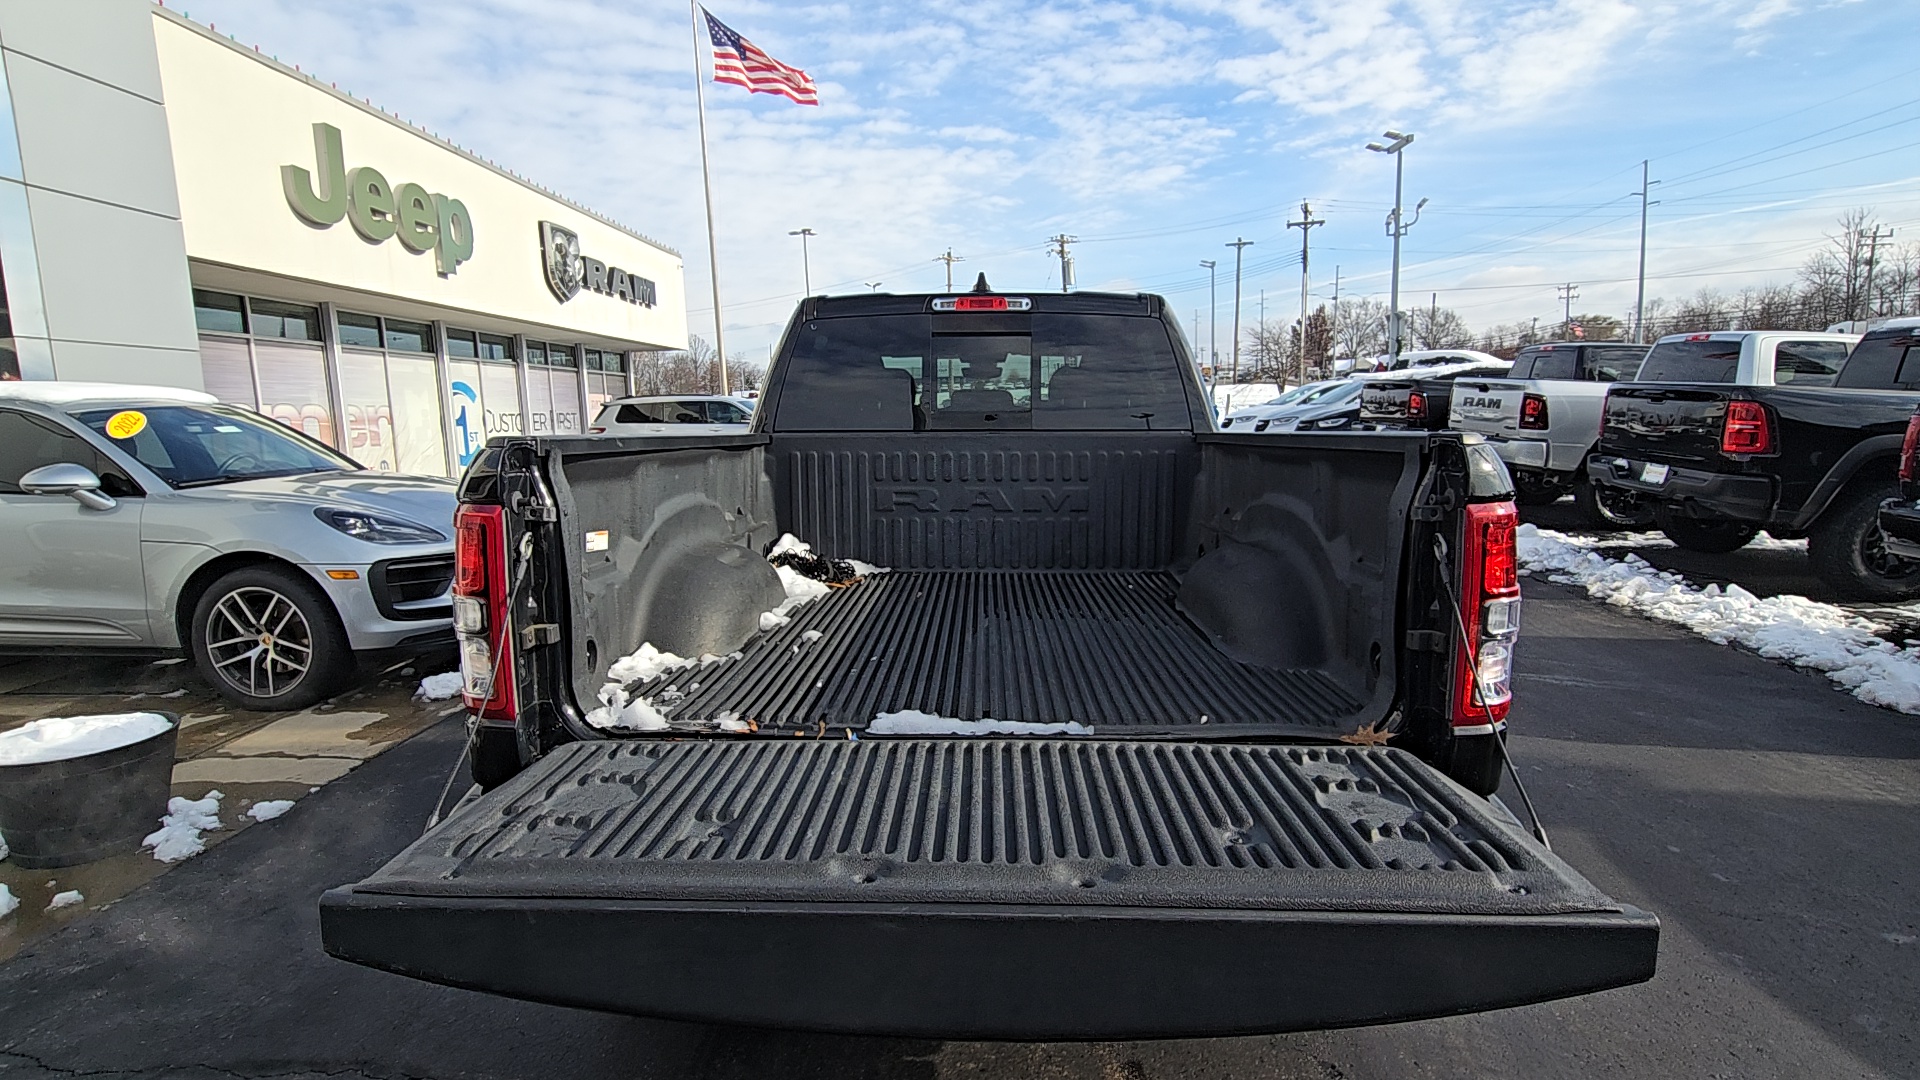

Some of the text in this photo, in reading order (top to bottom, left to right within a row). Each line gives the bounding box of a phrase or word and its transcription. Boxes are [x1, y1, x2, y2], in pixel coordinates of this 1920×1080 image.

[280, 122, 474, 279] Jeep
[580, 256, 657, 309] RAM
[1463, 396, 1503, 409] RAM
[230, 402, 392, 449] mer
[486, 409, 548, 433] USTOER
[1628, 410, 1685, 426] RAM
[874, 486, 1089, 513] RAM
